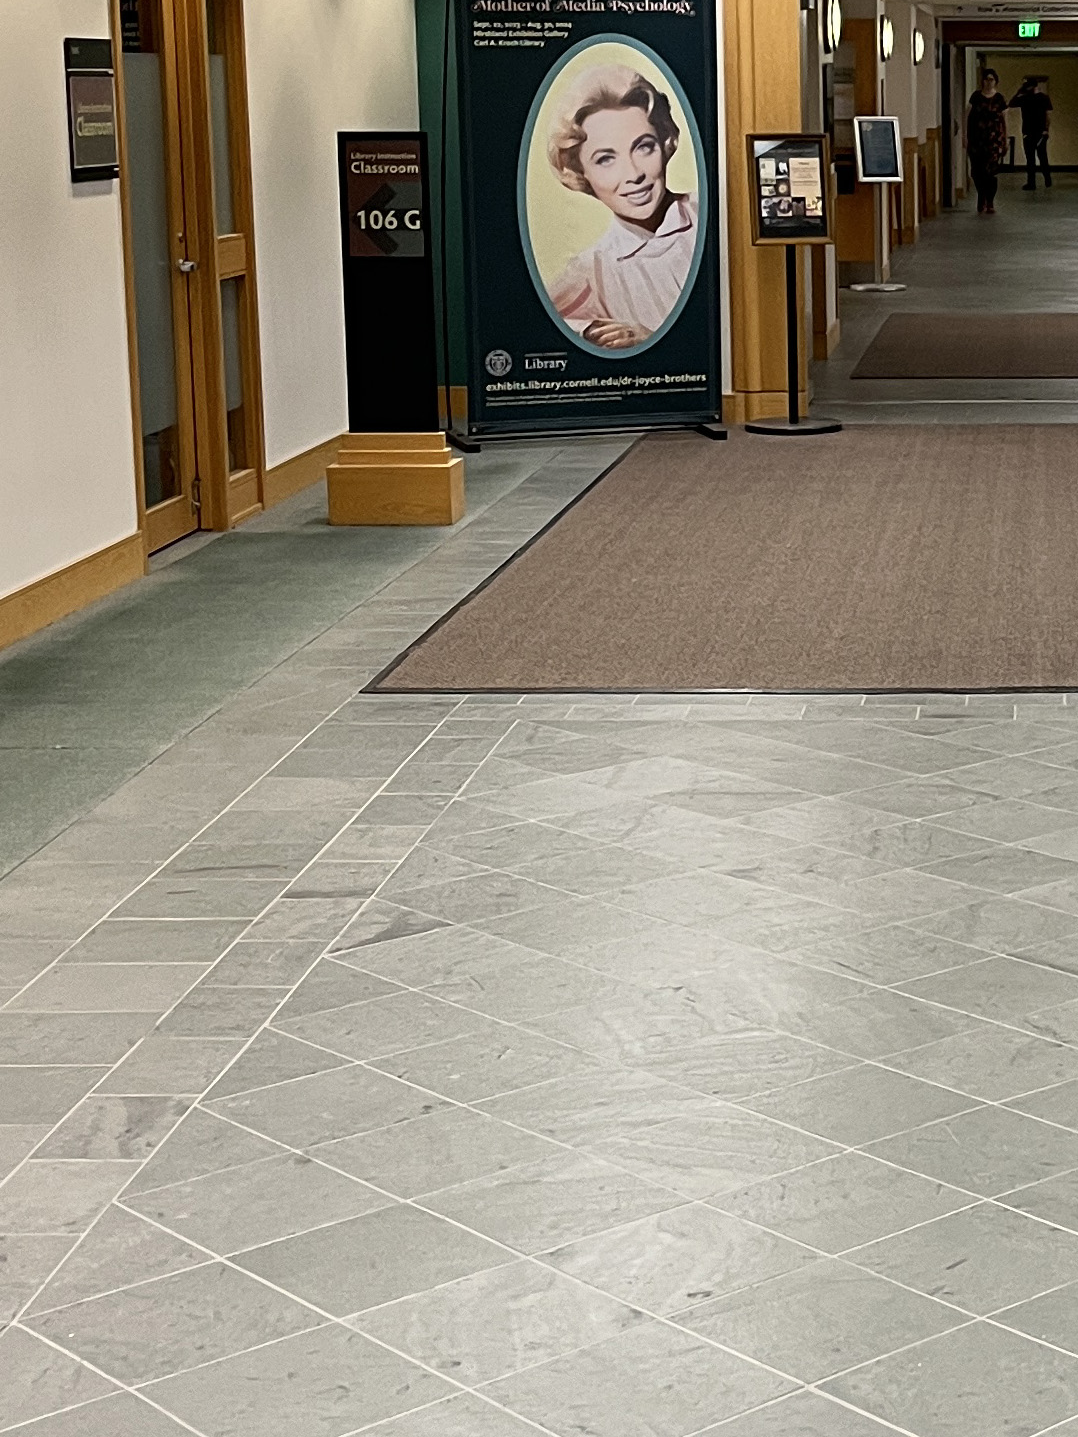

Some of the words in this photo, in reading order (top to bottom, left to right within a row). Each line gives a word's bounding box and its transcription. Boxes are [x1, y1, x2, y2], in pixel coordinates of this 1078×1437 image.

[471, 0, 535, 12] Mother
[553, 0, 605, 12] Media
[351, 161, 419, 174] Classroom
[357, 210, 398, 229] 106
[404, 210, 421, 229] G
[525, 358, 568, 372] Library
[485, 373, 707, 392] exhibits.library.cornell.edu/dr-joyce-brothers
